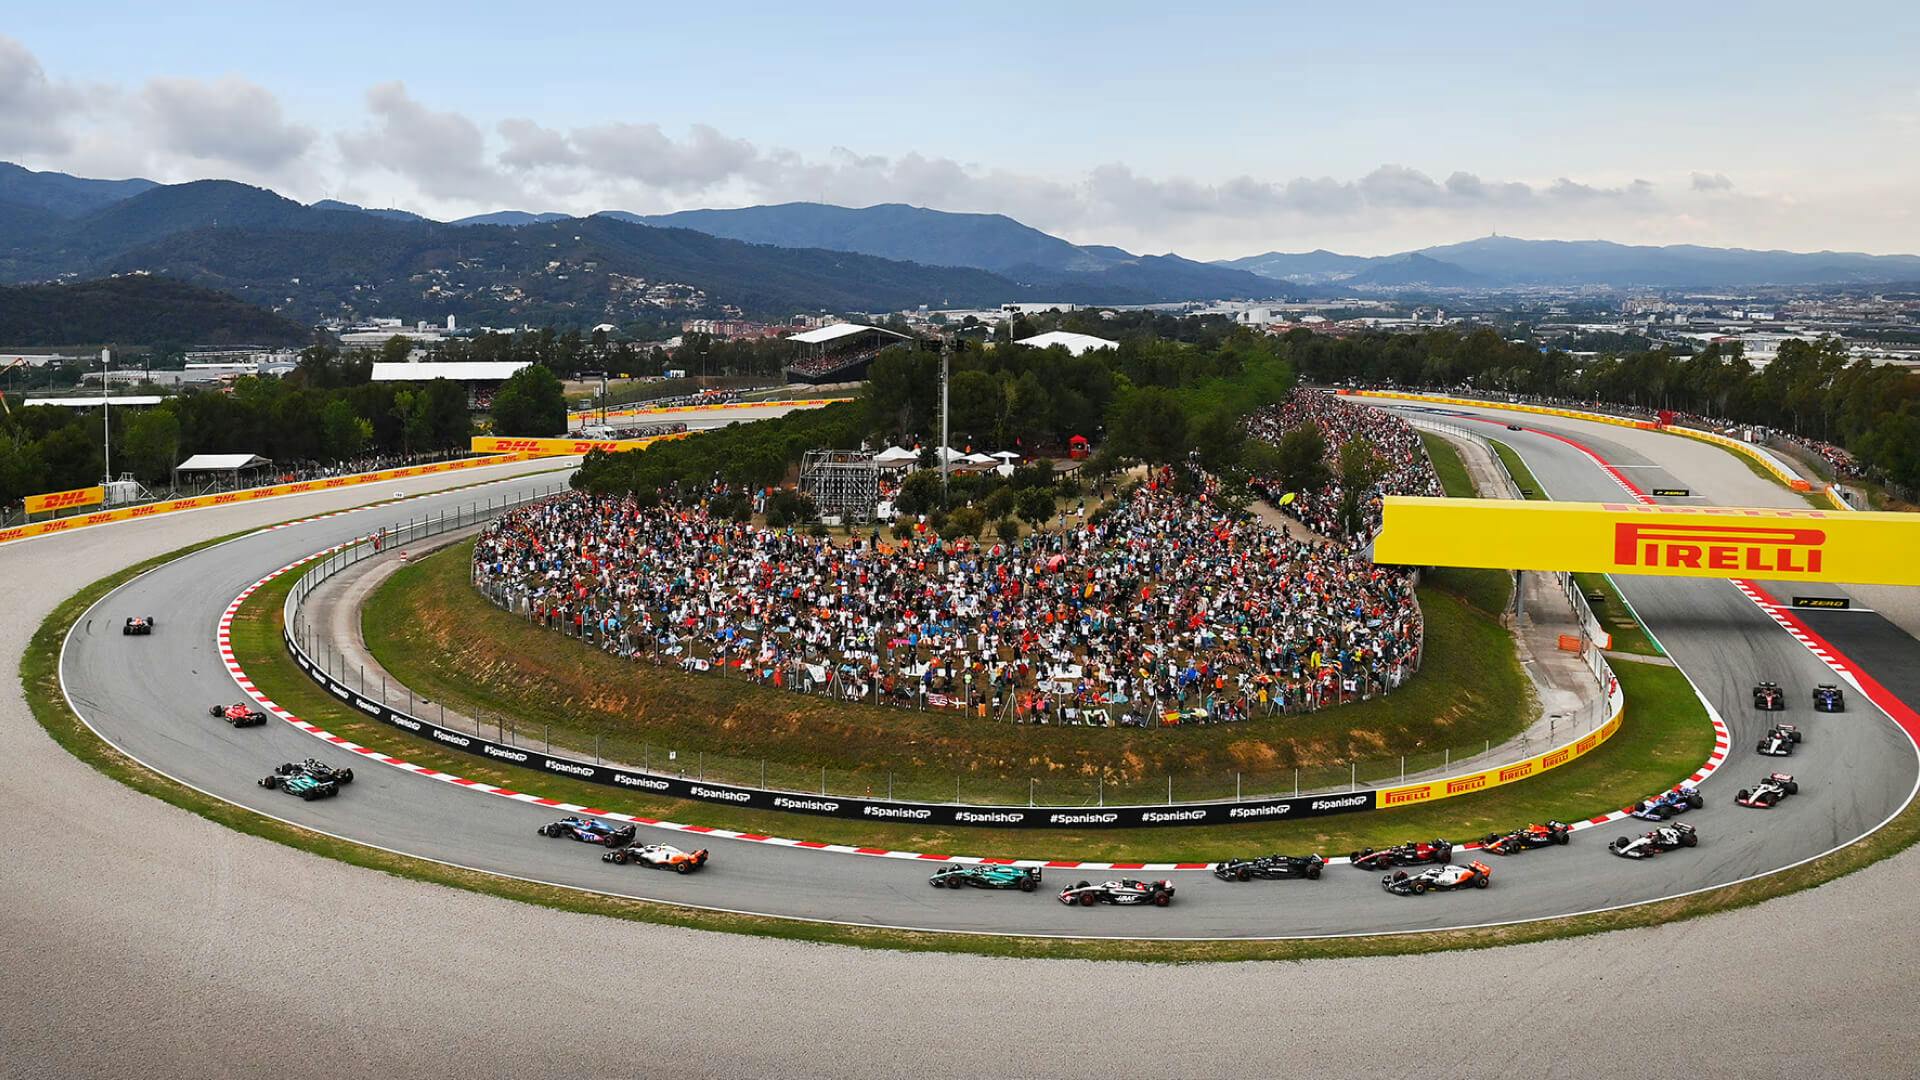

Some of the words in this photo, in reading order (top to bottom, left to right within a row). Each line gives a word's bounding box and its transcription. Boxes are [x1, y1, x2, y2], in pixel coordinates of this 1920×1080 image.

[495, 440, 540, 451] DHL
[291, 484, 311, 492] DHL
[326, 479, 345, 487] DHL
[215, 494, 236, 503] DHL
[253, 488, 274, 497] DHL
[44, 491, 87, 509] DHL
[174, 499, 197, 509] DHL
[132, 505, 155, 516] DHL
[87, 513, 112, 524] DHL
[43, 521, 68, 532] DHL
[1614, 522, 1827, 573] PIRELLI
[484, 744, 527, 763] #SpanishGP
[1543, 749, 1569, 769] PIRELLI
[545, 759, 594, 777] #SpanishGP
[1499, 762, 1532, 782] PIRELLI
[614, 774, 669, 790] #SpanishGP
[1446, 775, 1486, 794] PIRELLI
[690, 786, 751, 803] #SpanishGP
[1385, 786, 1431, 804] PIRELLI
[773, 797, 839, 812] #SpanishGP
[1311, 796, 1367, 810] #SpanishGP
[863, 806, 932, 819] #SpanishGP
[955, 812, 1024, 823] #SpanishGP
[1141, 810, 1207, 823] #SpanishGP
[1229, 804, 1291, 818] #SpanishGP
[1050, 813, 1118, 824] #SpanishGP
